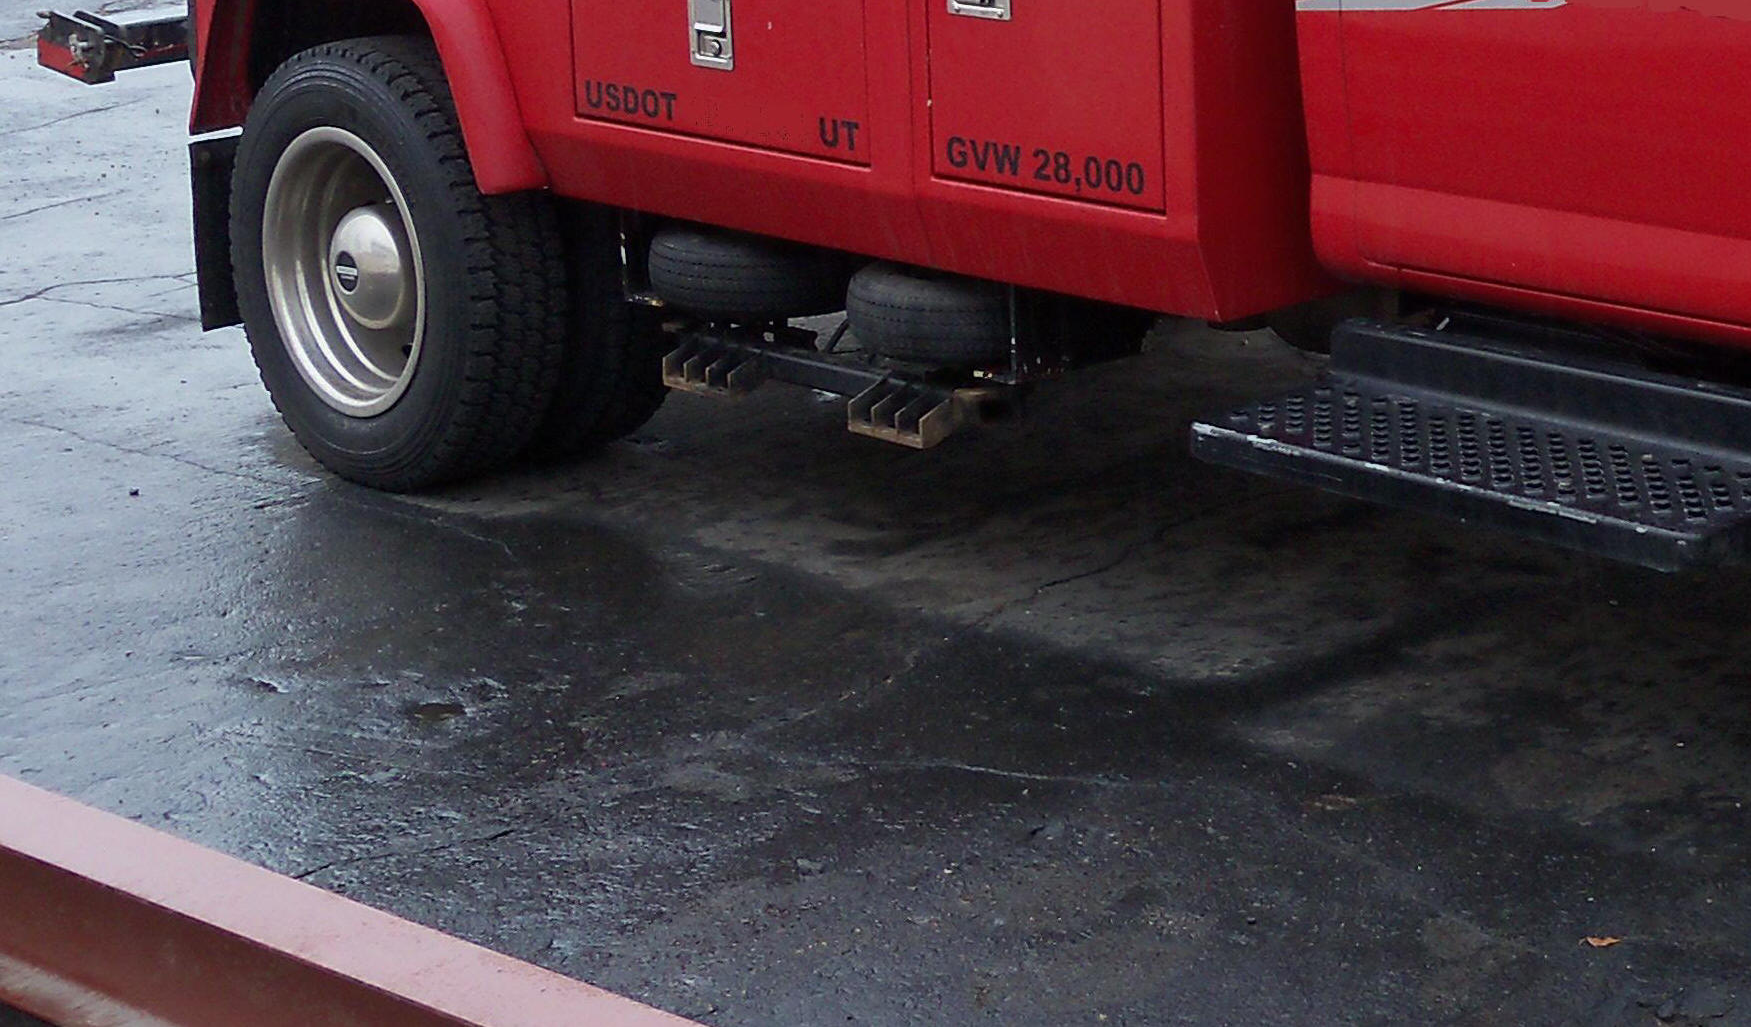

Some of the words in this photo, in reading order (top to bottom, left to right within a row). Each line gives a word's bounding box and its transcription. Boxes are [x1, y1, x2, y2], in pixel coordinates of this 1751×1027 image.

[584, 79, 677, 122] USDOT
[819, 116, 859, 151] UT
[946, 136, 1022, 177] GVW
[1032, 147, 1145, 196] 28,000
